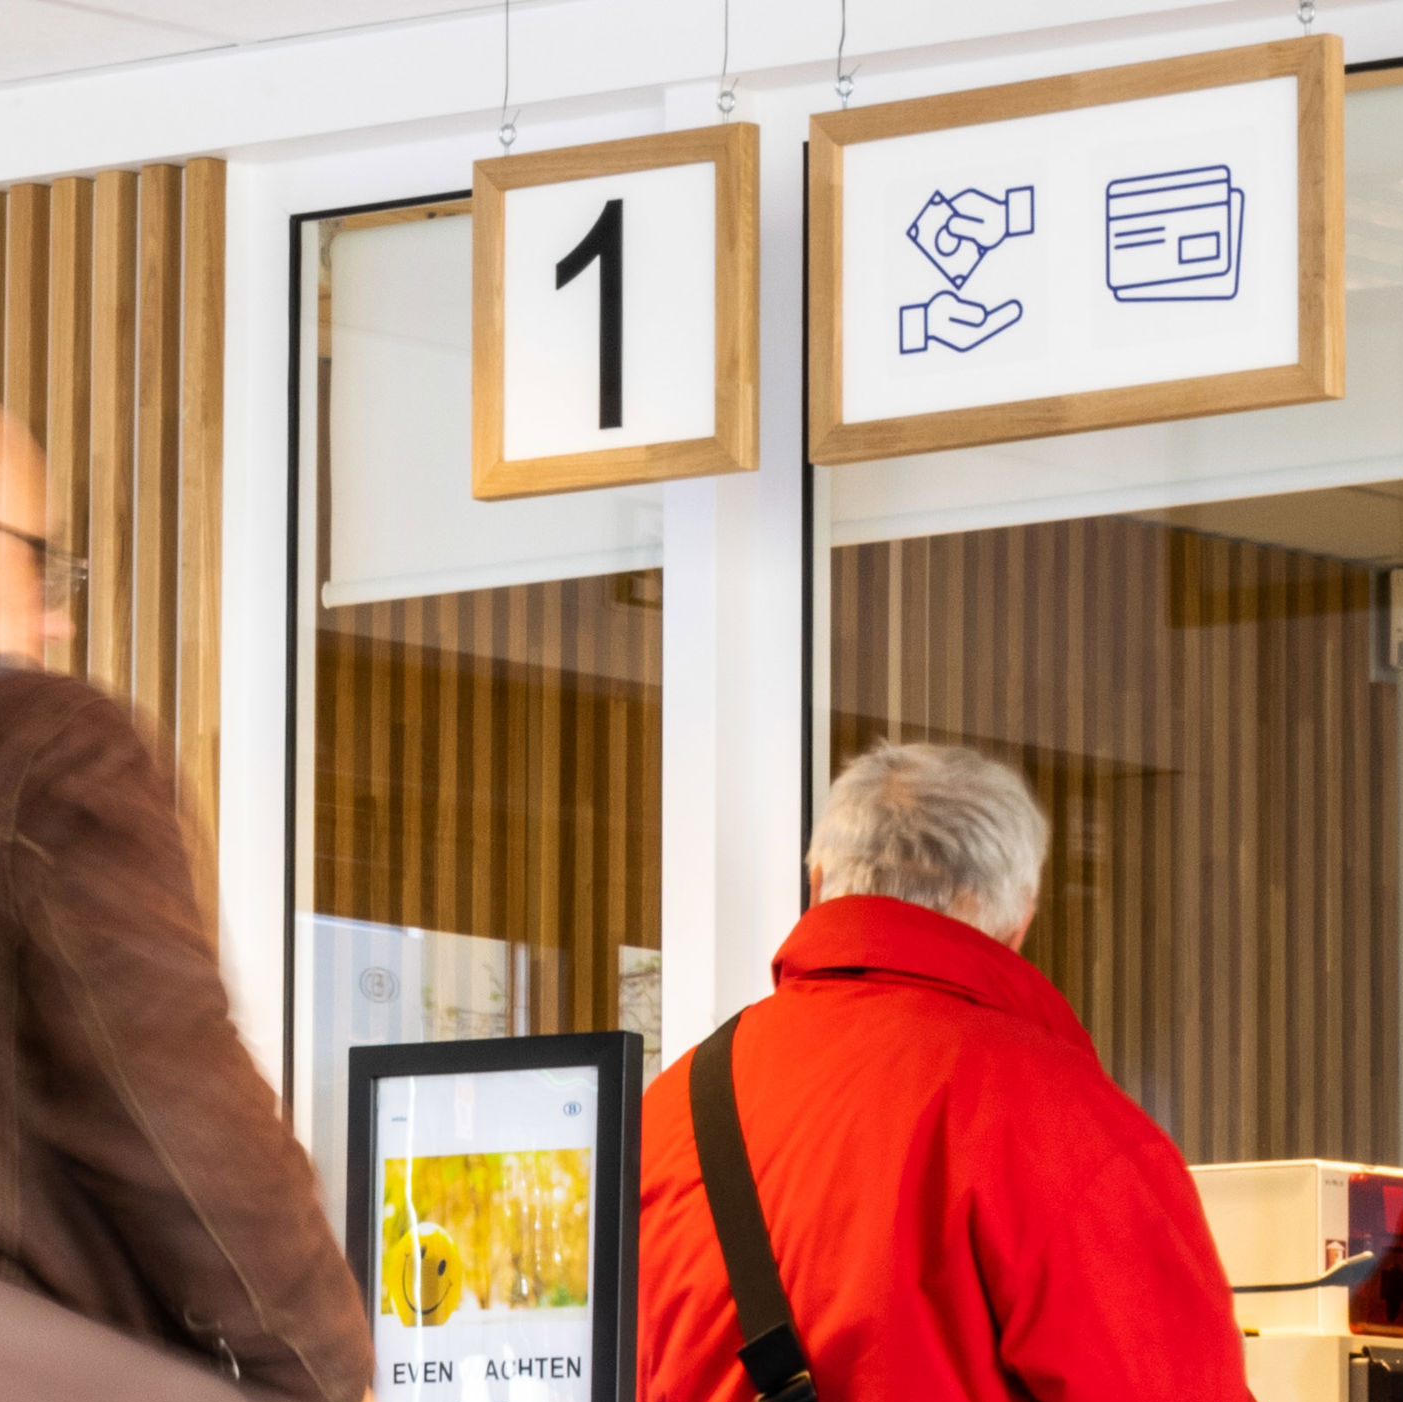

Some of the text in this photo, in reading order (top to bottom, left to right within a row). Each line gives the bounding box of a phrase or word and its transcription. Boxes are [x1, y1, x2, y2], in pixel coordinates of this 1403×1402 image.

[555, 199, 623, 430] 1
[393, 1356, 581, 1385] EVEN ACHTEN
